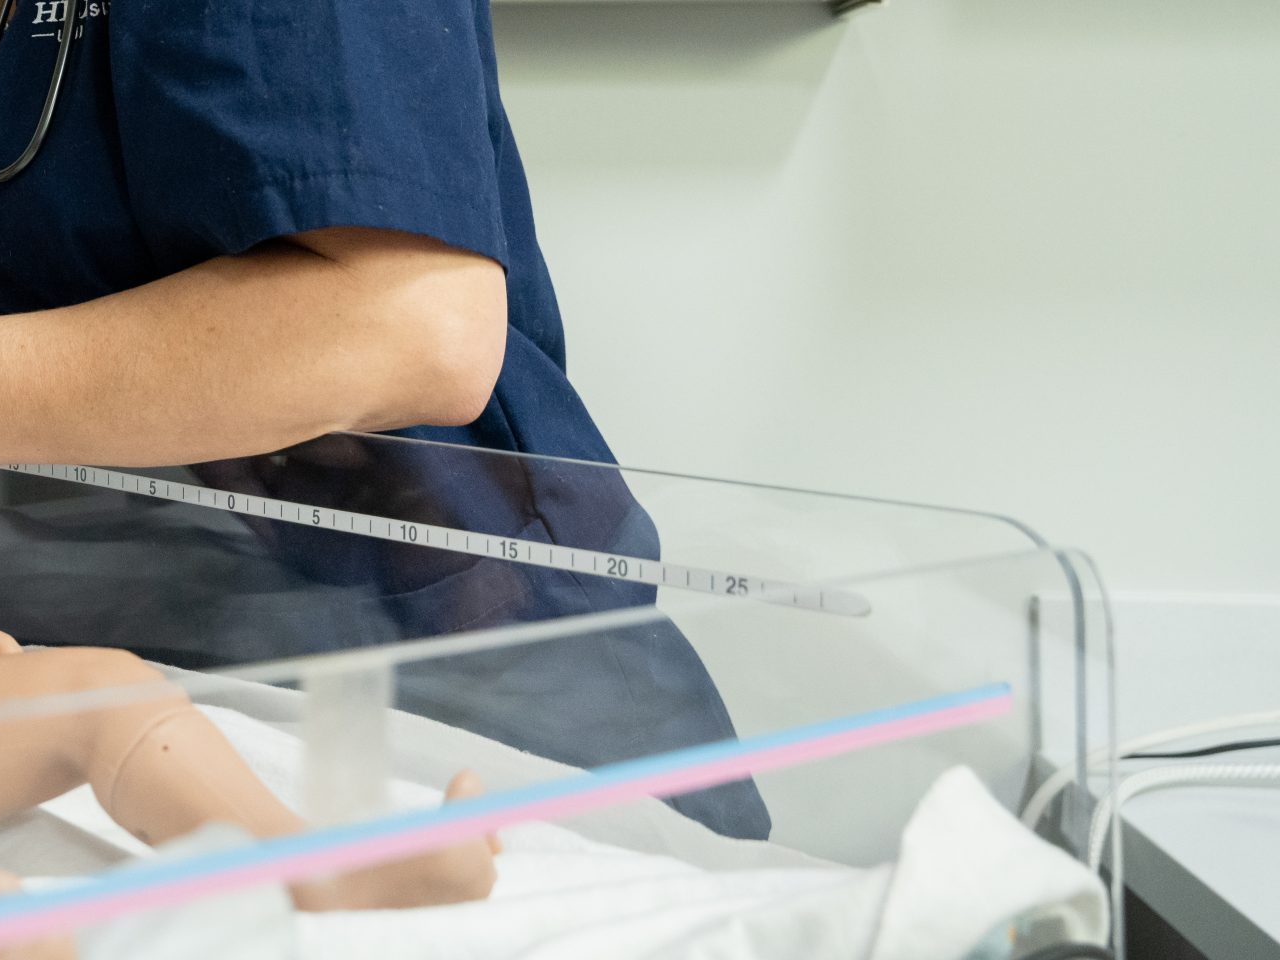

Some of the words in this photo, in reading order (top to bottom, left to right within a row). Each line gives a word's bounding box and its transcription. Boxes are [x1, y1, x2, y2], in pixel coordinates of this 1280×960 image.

[73, 468, 86, 483] 10
[149, 480, 157, 496] 5
[227, 495, 235, 510] 0
[312, 509, 321, 525] 5
[400, 524, 418, 542] 10
[499, 541, 518, 559] 15
[607, 558, 628, 577] 20
[726, 576, 749, 596] 25
